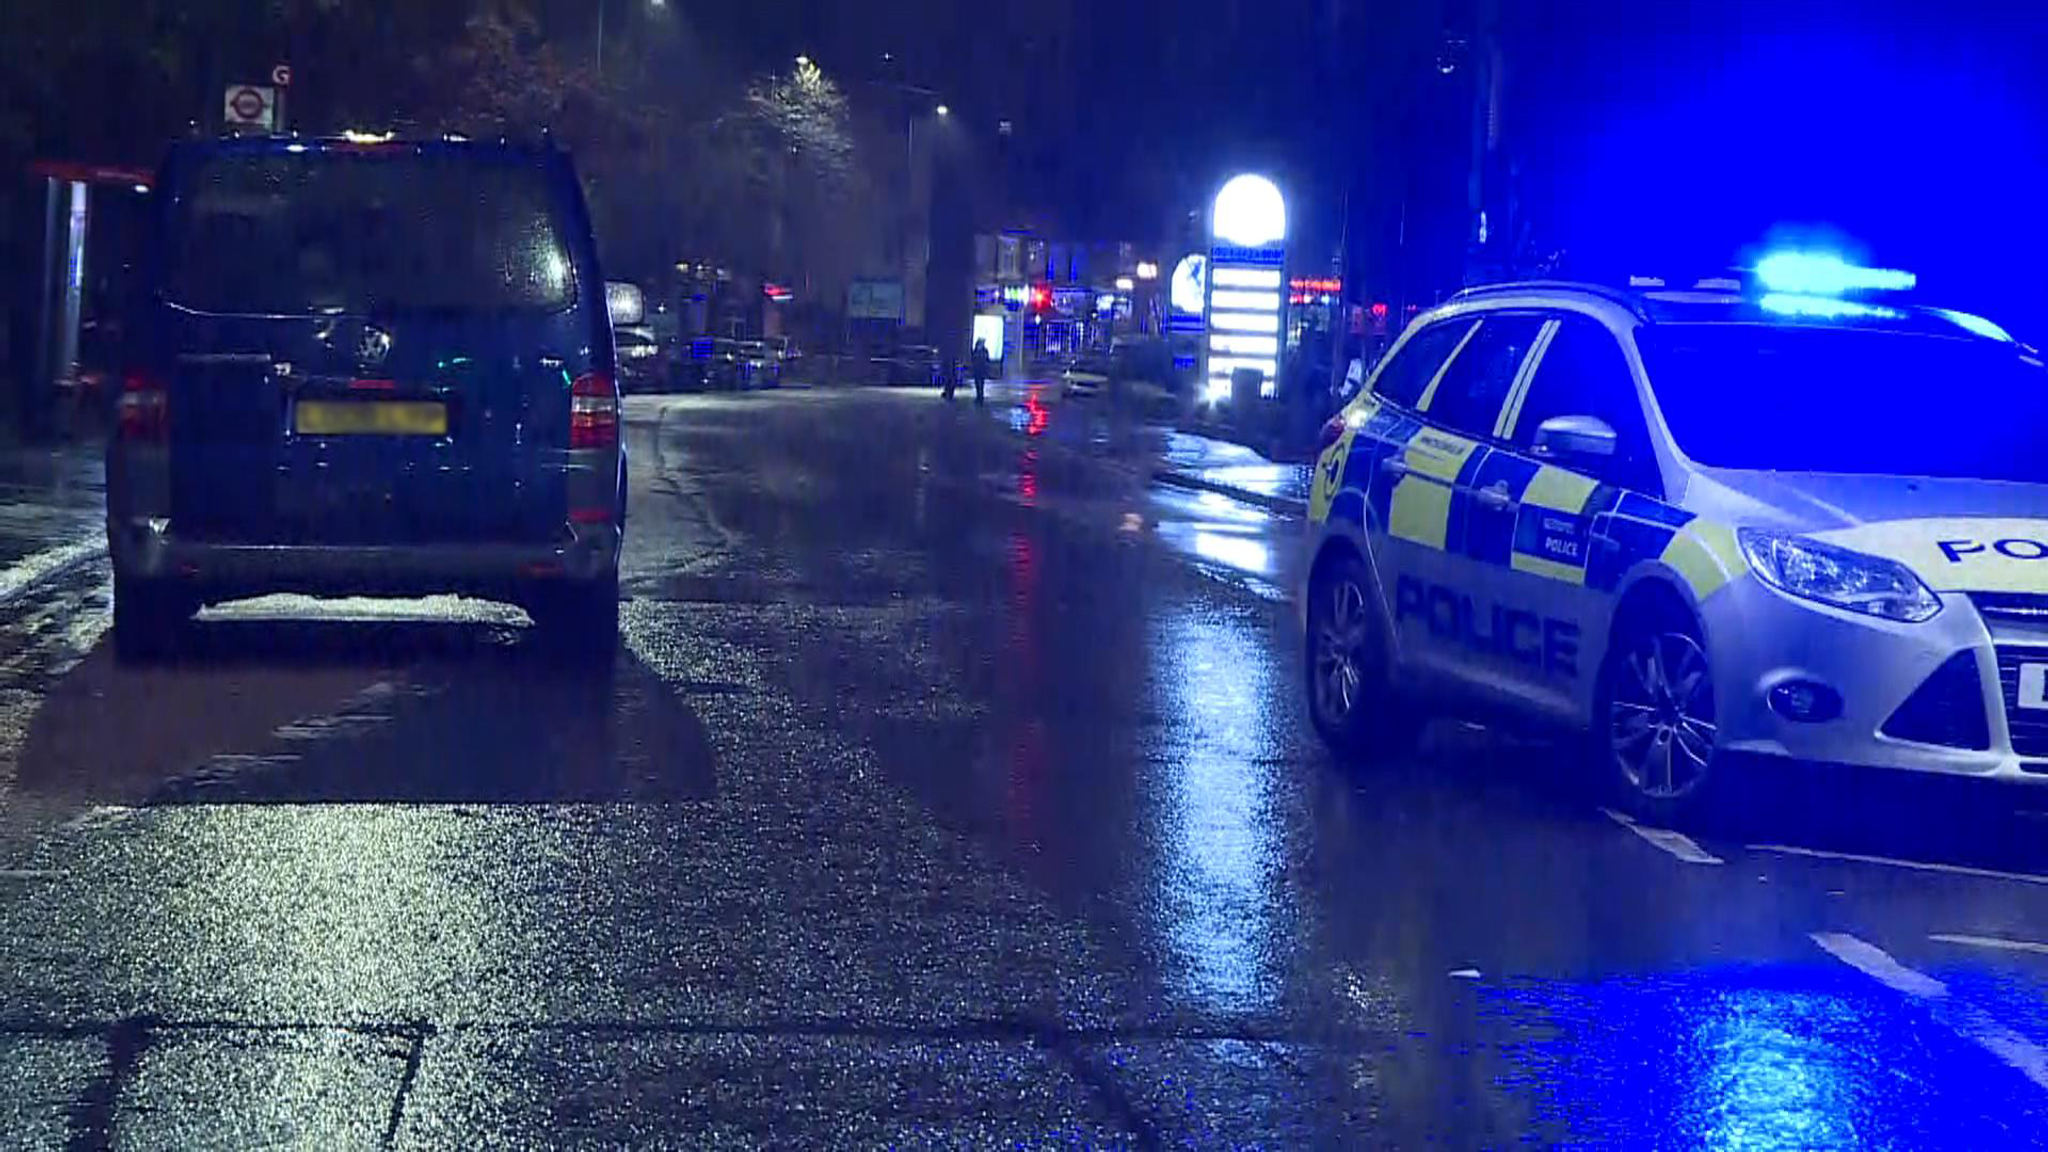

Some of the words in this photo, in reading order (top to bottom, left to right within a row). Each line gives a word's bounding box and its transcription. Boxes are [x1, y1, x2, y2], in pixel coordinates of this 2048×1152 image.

[273, 65, 290, 85] G
[1545, 536, 1579, 557] POLICE
[1395, 571, 1580, 679] POLICE
